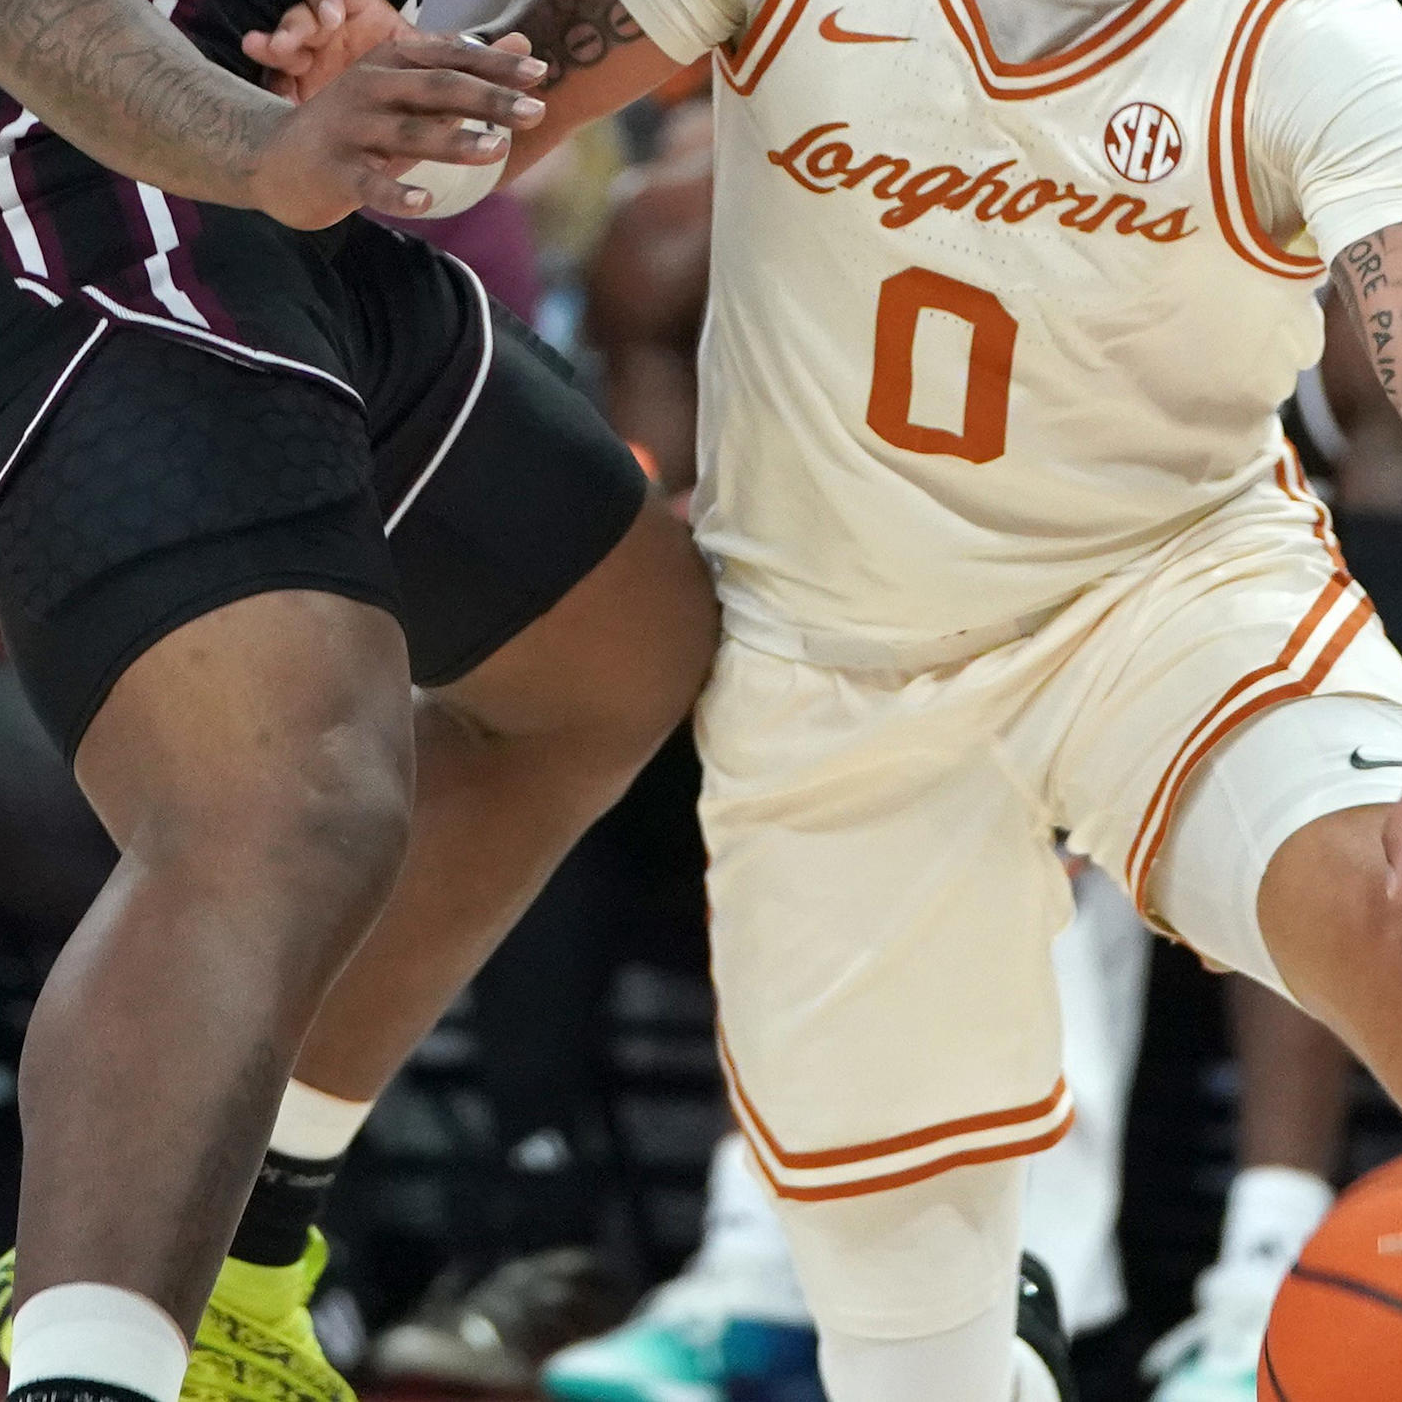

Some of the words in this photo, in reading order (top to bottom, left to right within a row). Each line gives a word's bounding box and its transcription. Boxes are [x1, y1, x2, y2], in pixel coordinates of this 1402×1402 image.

[767, 121, 1200, 243] Longhorns
[1105, 103, 1181, 183] SEC
[1346, 240, 1388, 300] ORE
[866, 266, 1019, 465] 0
